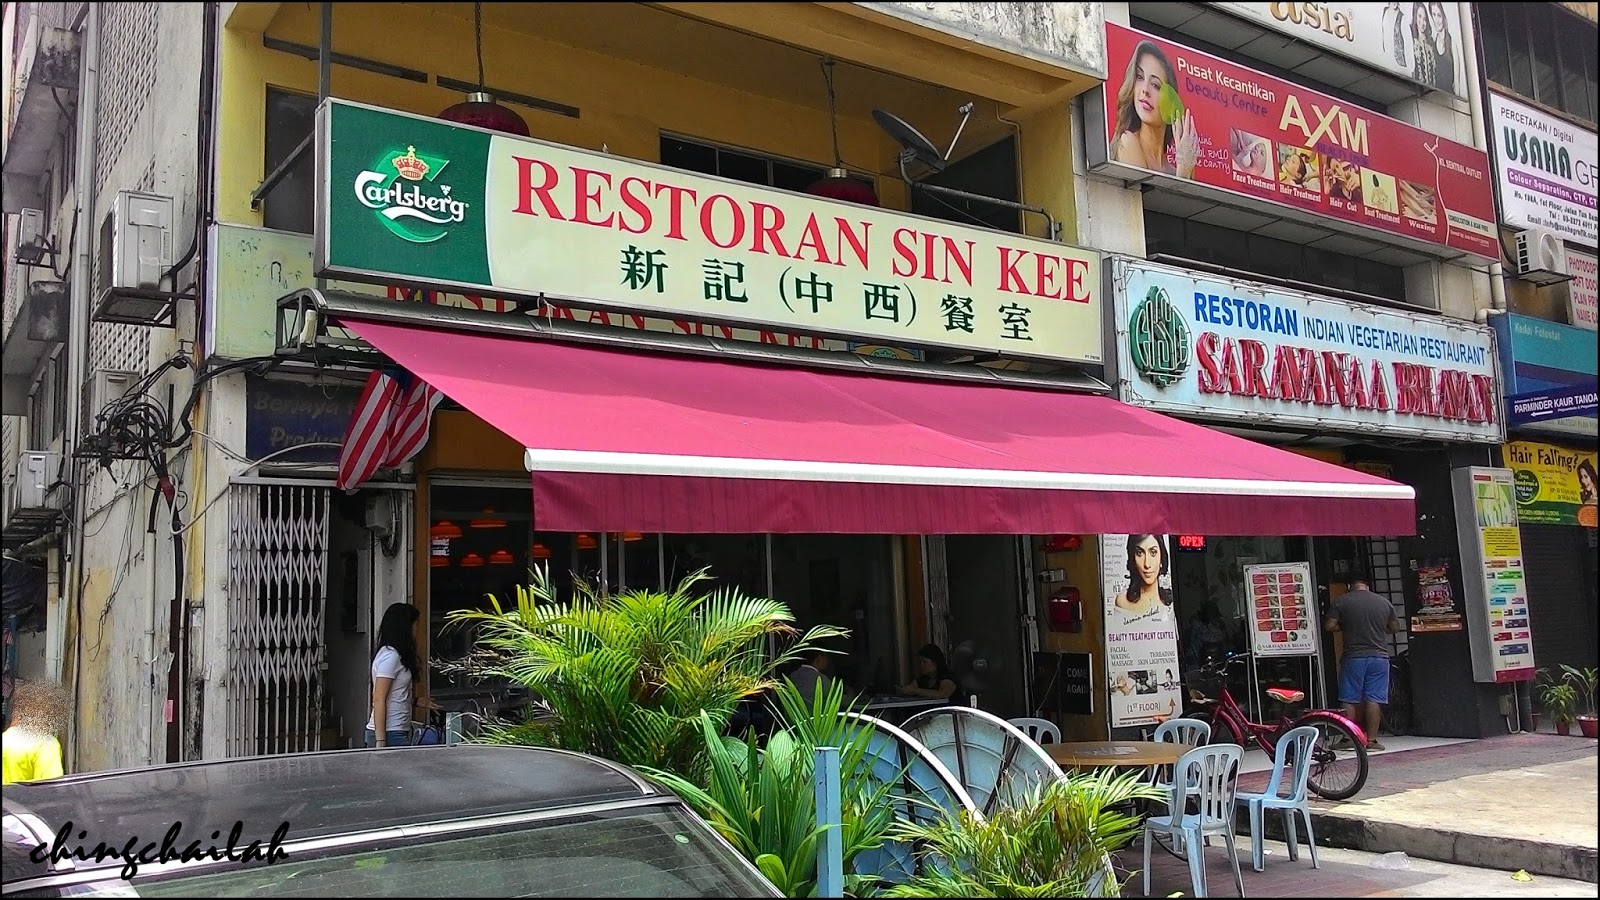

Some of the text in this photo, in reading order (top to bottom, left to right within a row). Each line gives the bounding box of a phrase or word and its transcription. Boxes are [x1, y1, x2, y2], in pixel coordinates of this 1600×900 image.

[1177, 57, 1276, 103] Pusat Kecantikan
[1186, 77, 1268, 117] Beauty Centre
[1279, 94, 1369, 156] AXM
[1500, 107, 1548, 134] PERCETAKAN
[1553, 127, 1574, 144] Digital
[1503, 125, 1573, 180] USAHA
[1232, 171, 1246, 184] Face
[1247, 174, 1276, 191] Treatment
[1280, 184, 1293, 195] Hair
[1293, 187, 1322, 203] Treatment
[1509, 170, 1532, 186] Colour
[1533, 179, 1572, 200] Separation,
[354, 170, 466, 222] Carlsberg
[1329, 196, 1343, 209] Hair
[1346, 200, 1358, 213] Cut
[511, 155, 1091, 304] RESTORAN SIN KEE
[1408, 219, 1436, 234] Waxing
[1569, 256, 1598, 275] PHOTOCOP
[1194, 292, 1486, 366] RESTORAN INDIAN VEGETARIAN RESTAURANT
[1196, 331, 1496, 425] SARAVANAA BHAVAN
[1514, 399, 1553, 413] PARMINDER
[1554, 396, 1574, 408] KAUR
[1509, 445, 1579, 473] Hair Falling?
[1180, 535, 1204, 547] OPEN
[1108, 631, 1174, 642] BEAUTY TREATMENT CENTRE
[1139, 702, 1161, 712] FLOOR)
